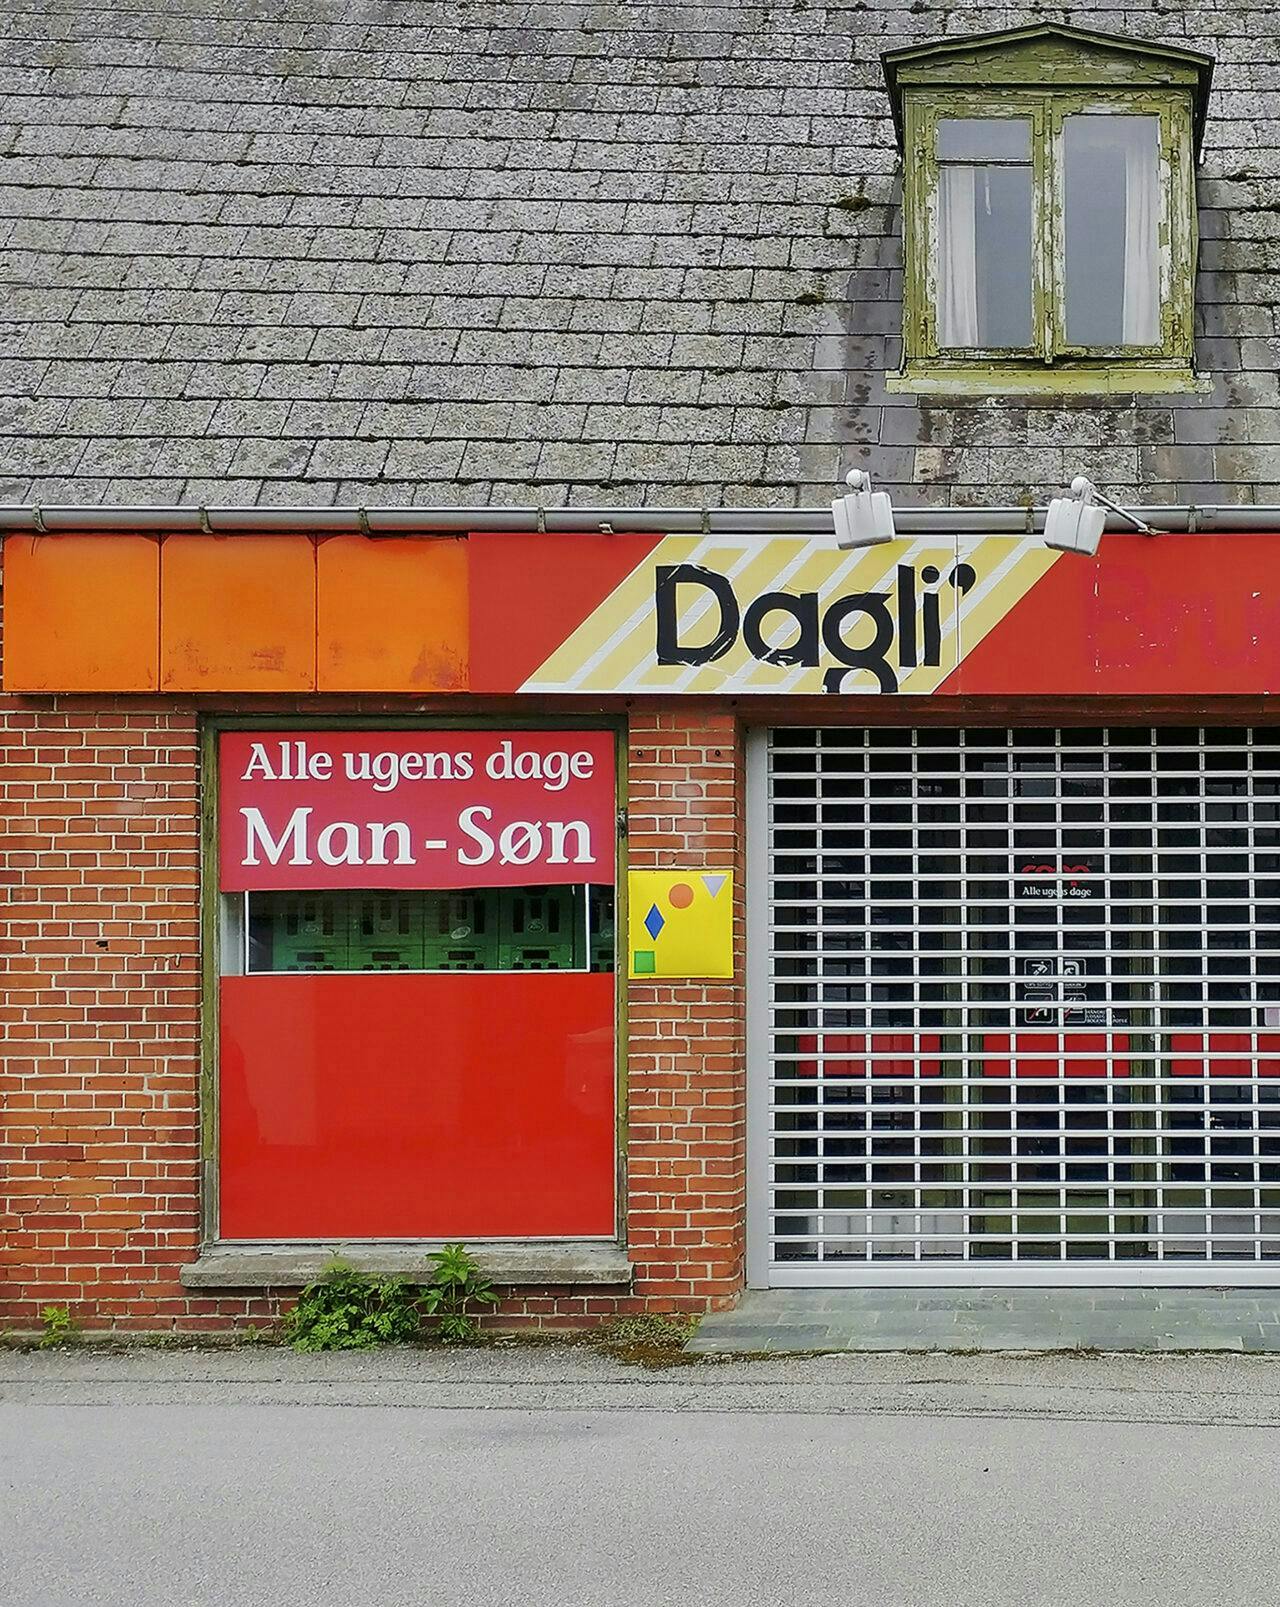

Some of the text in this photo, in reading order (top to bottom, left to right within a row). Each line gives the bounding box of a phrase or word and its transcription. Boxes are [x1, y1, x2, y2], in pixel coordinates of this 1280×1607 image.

[240, 741, 594, 792] Alle ugens dage
[239, 806, 417, 866] Man
[457, 805, 597, 867] Søn
[1022, 886, 1092, 898] Alle uges dage
